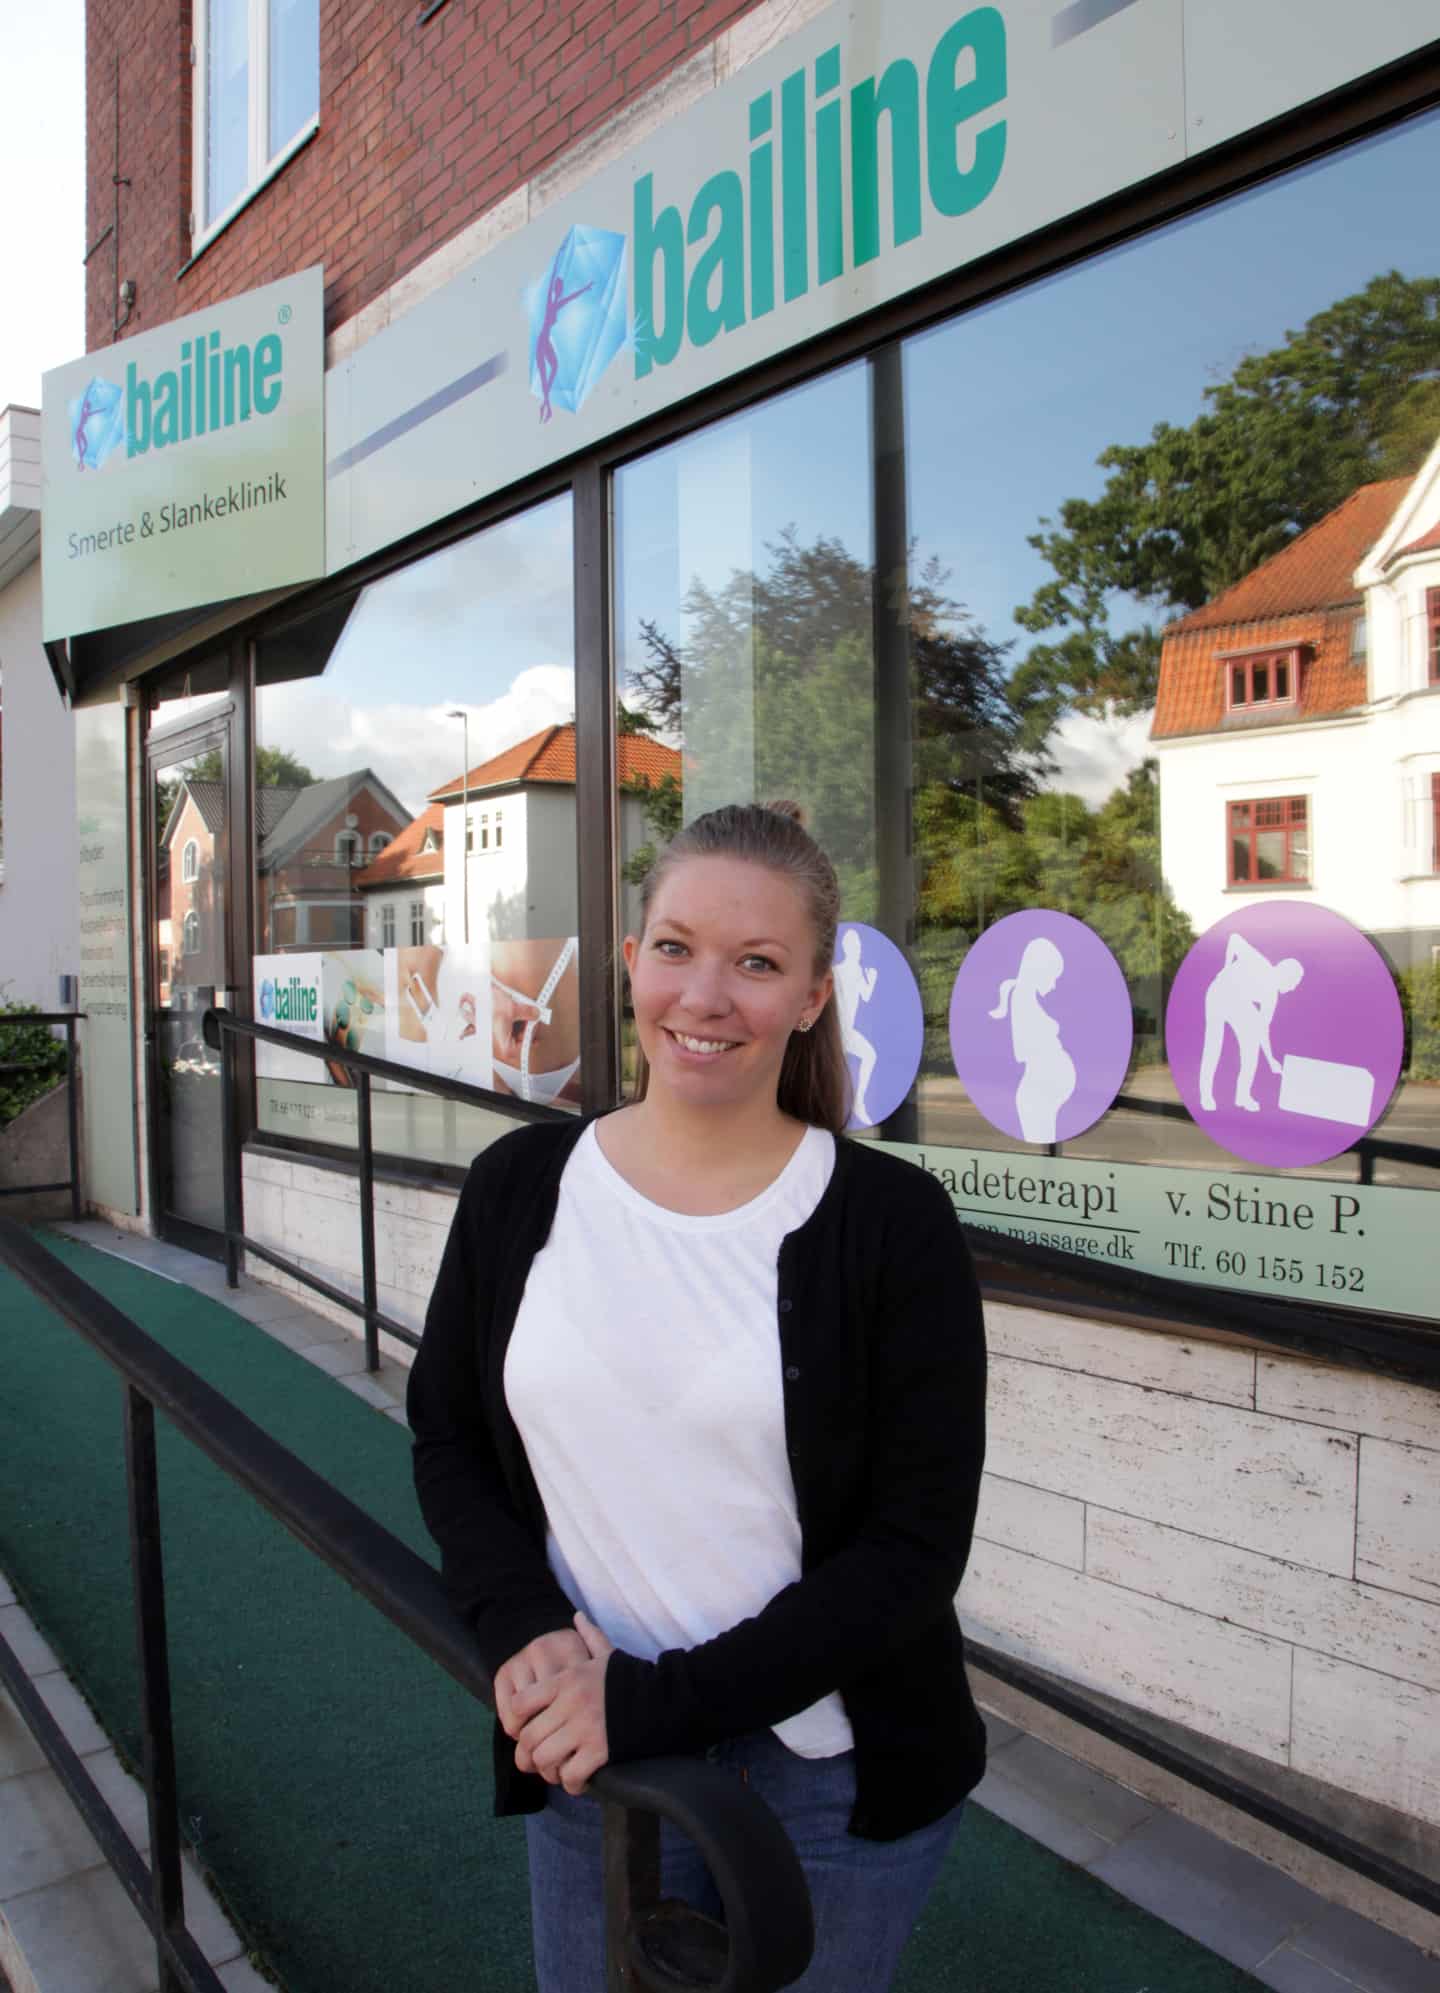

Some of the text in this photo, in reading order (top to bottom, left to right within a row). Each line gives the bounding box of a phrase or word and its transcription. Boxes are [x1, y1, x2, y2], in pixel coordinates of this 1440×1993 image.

[634, 6, 1008, 382] bailine
[126, 329, 283, 459] bailine
[67, 471, 288, 560] Smerte & Slankeklinik
[274, 976, 318, 1022] bailine
[1164, 1190, 1192, 1217] v.
[1207, 1182, 1315, 1230] Stine
[1329, 1193, 1366, 1237] P.
[1164, 1240, 1206, 1271] Tlf.
[1215, 1249, 1247, 1276] 60
[1256, 1255, 1304, 1284] 155
[1315, 1263, 1365, 1293] 152
